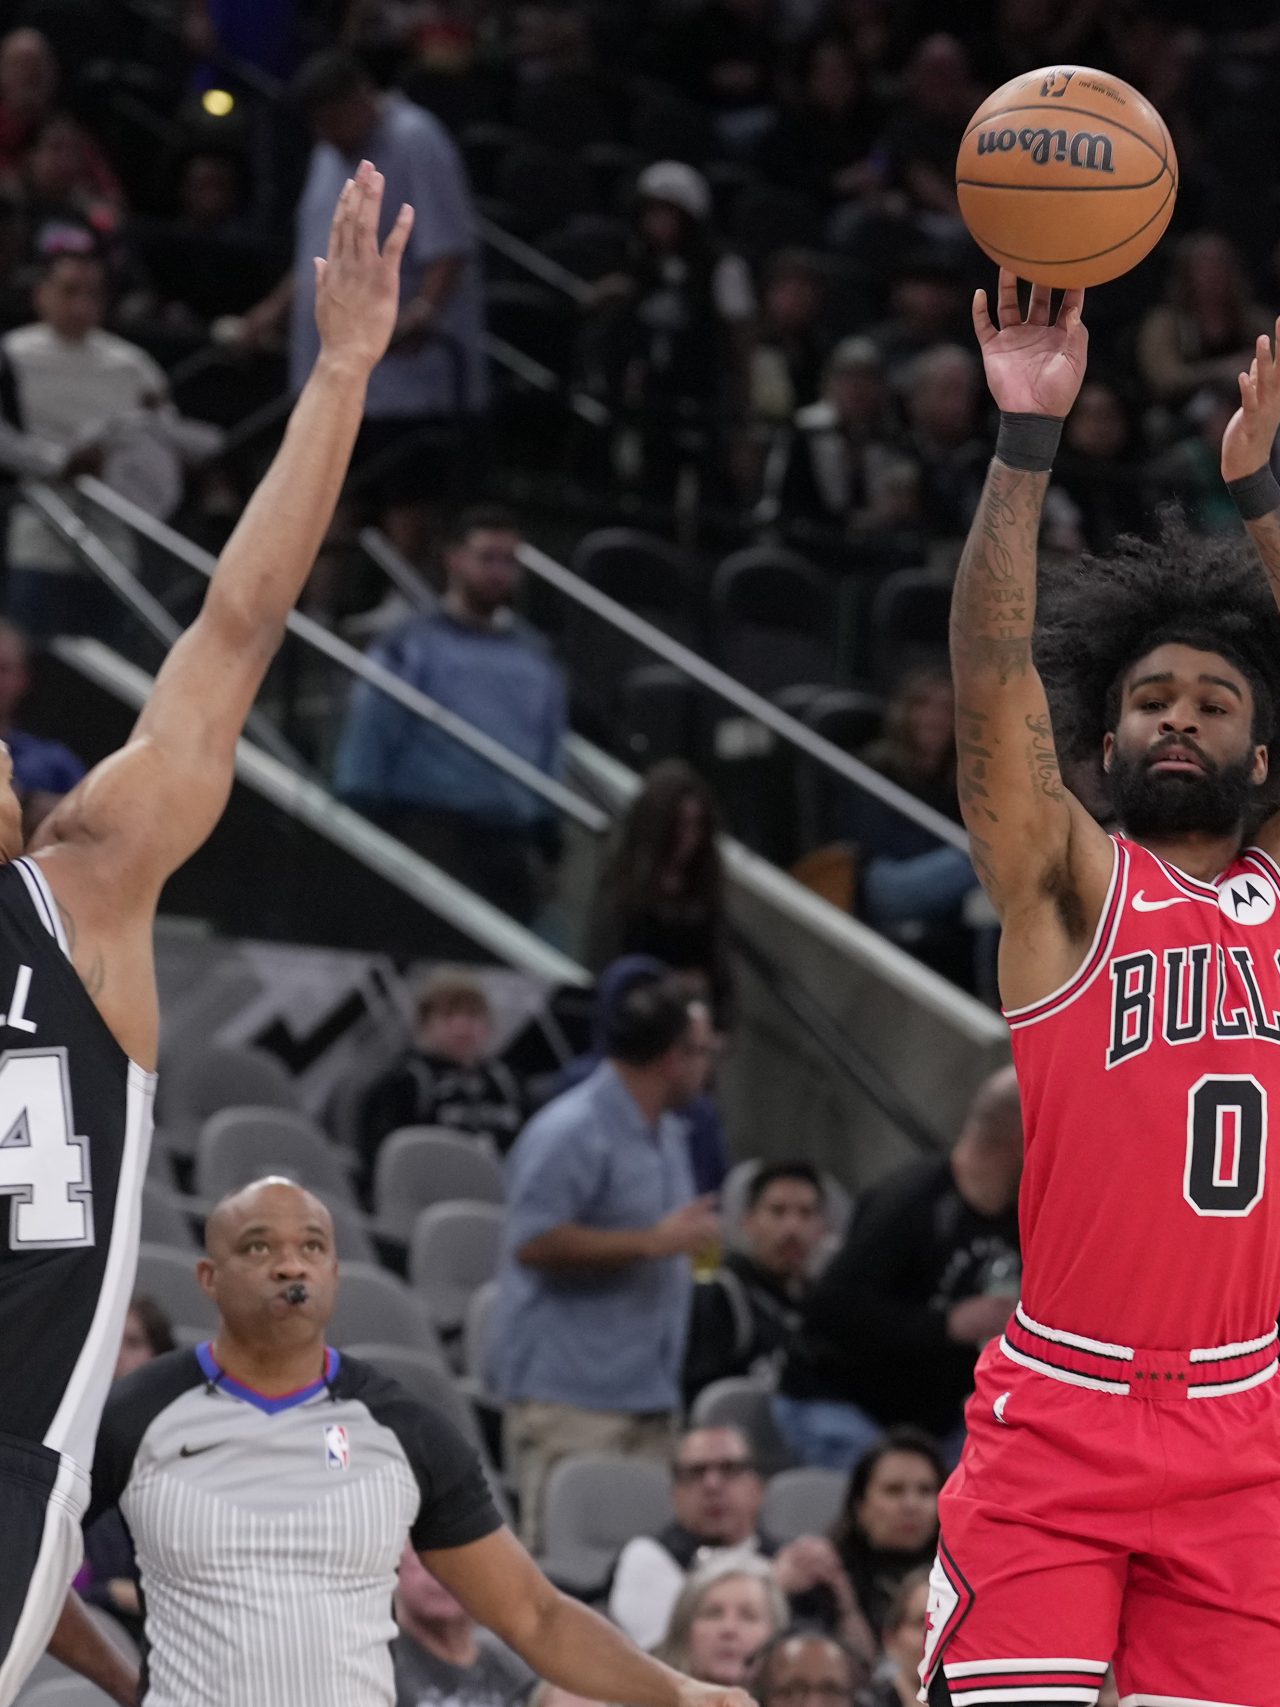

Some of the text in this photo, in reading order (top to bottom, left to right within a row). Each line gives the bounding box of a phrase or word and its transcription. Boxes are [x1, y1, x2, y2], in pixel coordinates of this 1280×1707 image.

[977, 128, 1115, 173] Wilson
[0, 964, 37, 1034] L
[0, 1046, 96, 1251] 4
[1183, 1073, 1267, 1217] 0
